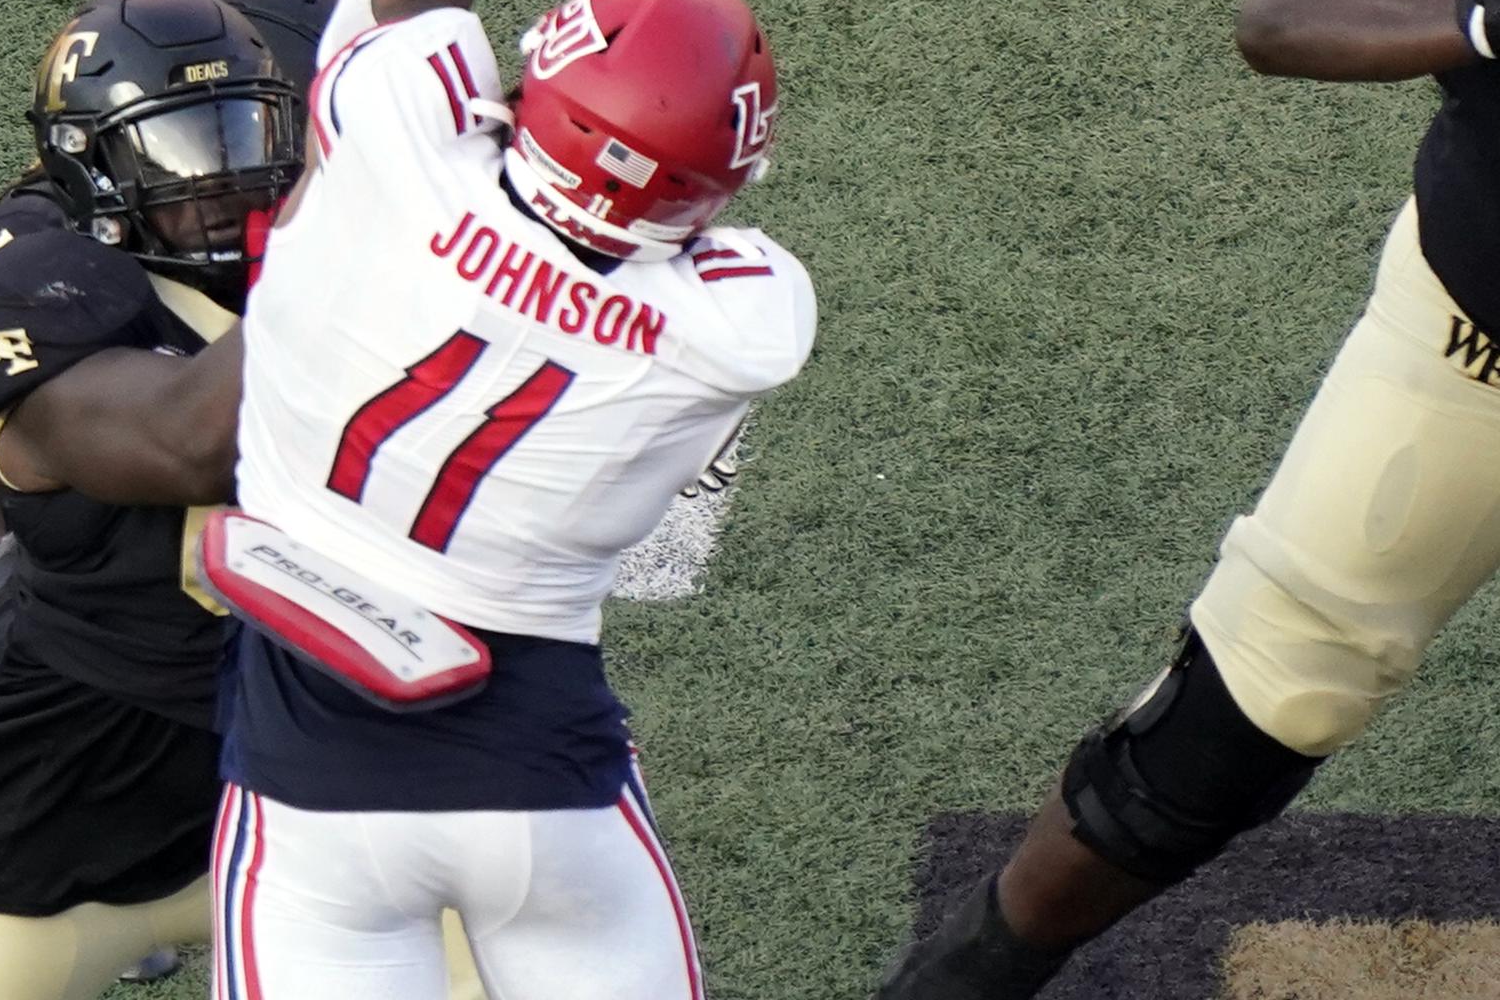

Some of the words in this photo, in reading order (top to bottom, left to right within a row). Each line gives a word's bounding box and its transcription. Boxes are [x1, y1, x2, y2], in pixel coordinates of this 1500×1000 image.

[185, 61, 229, 83] DEACS
[427, 41, 483, 136] 11
[586, 193, 614, 230] 11
[430, 212, 668, 356] JOHNSON
[326, 328, 577, 555] 11
[252, 544, 423, 646] PRO-GEAR
